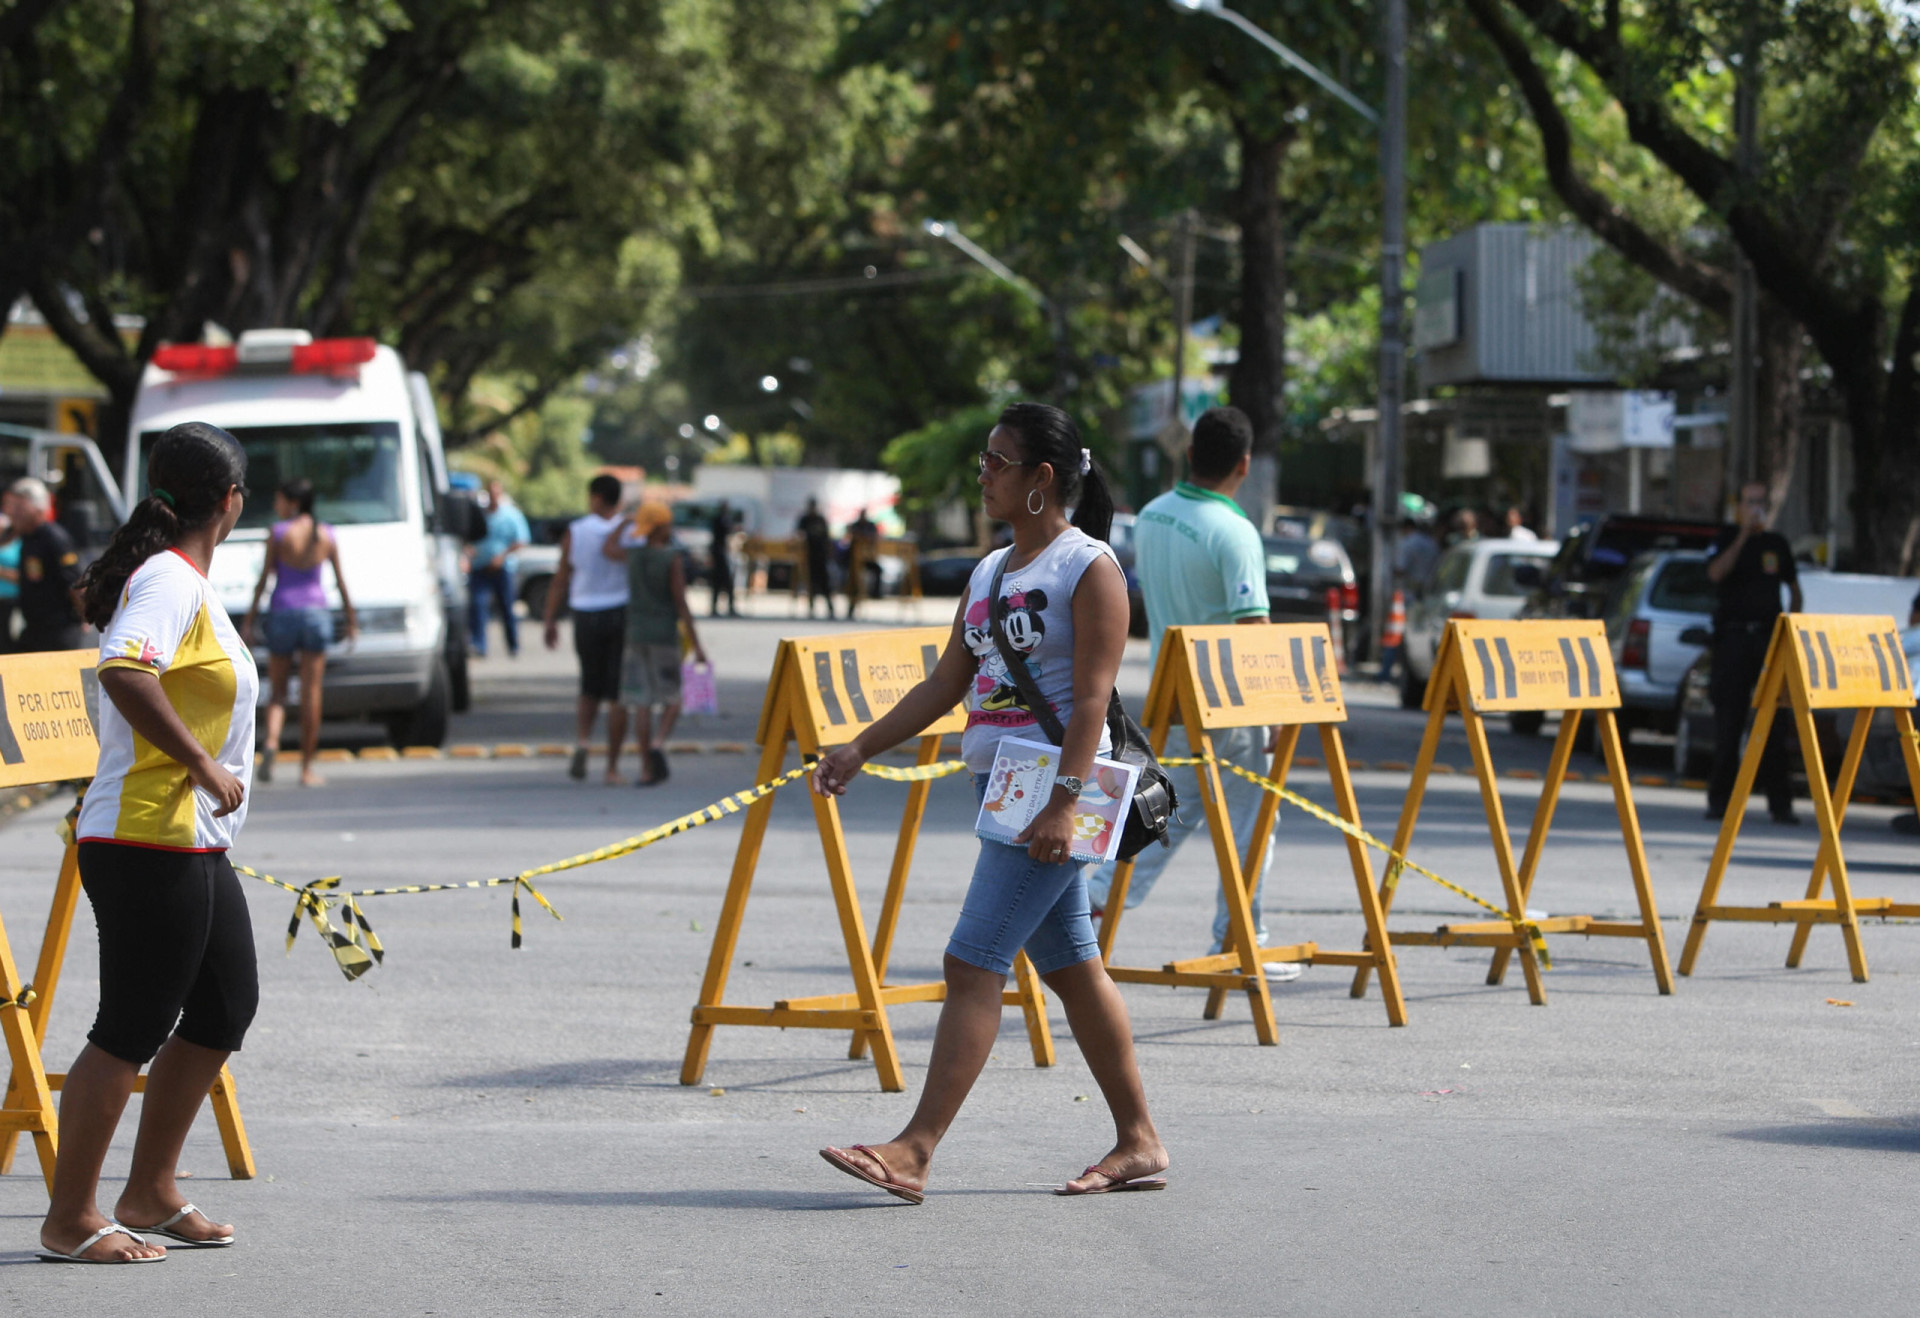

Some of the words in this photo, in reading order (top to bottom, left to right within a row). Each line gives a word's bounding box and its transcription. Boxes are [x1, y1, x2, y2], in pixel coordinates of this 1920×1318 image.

[868, 666, 889, 681] PCR
[896, 664, 922, 680] CTTU
[18, 693, 44, 712] PCR
[51, 690, 81, 710] CTTU
[23, 722, 50, 741] 0800
[50, 720, 64, 739] 81
[66, 718, 91, 737] 1078
[1029, 794, 1038, 808] DAS
[1034, 769, 1045, 793] LETRAS
